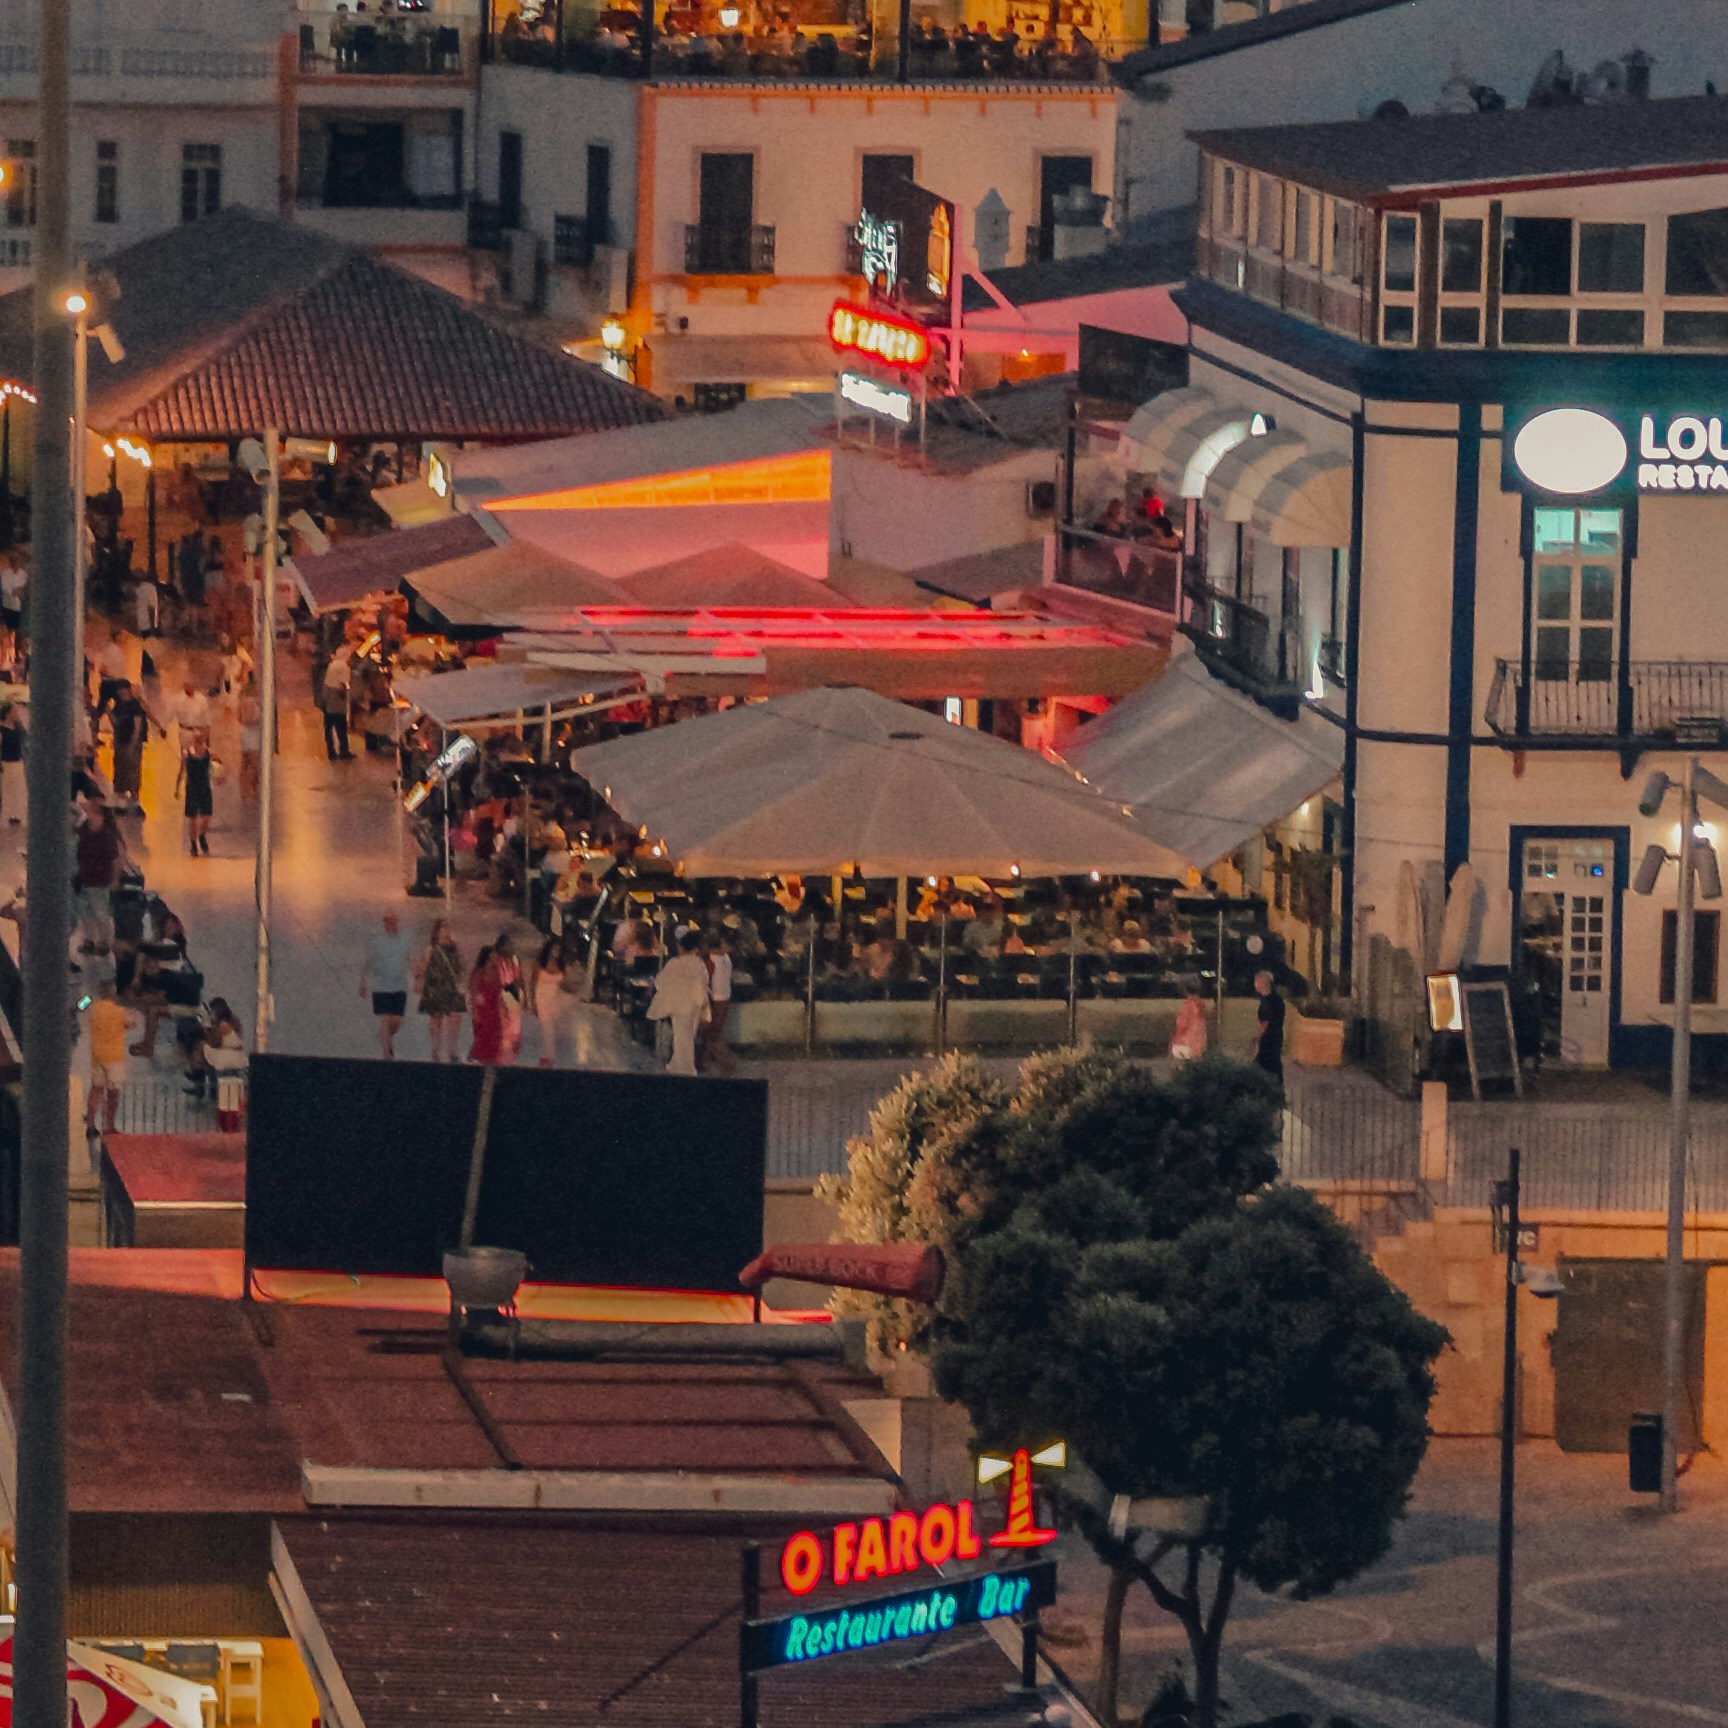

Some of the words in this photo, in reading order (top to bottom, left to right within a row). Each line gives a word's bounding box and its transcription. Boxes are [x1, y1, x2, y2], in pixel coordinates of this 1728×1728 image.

[782, 1531, 823, 1595] O
[834, 1499, 981, 1586] FAROL
[784, 1591, 957, 1662] Restaurante
[978, 1574, 1030, 1619] Bar
